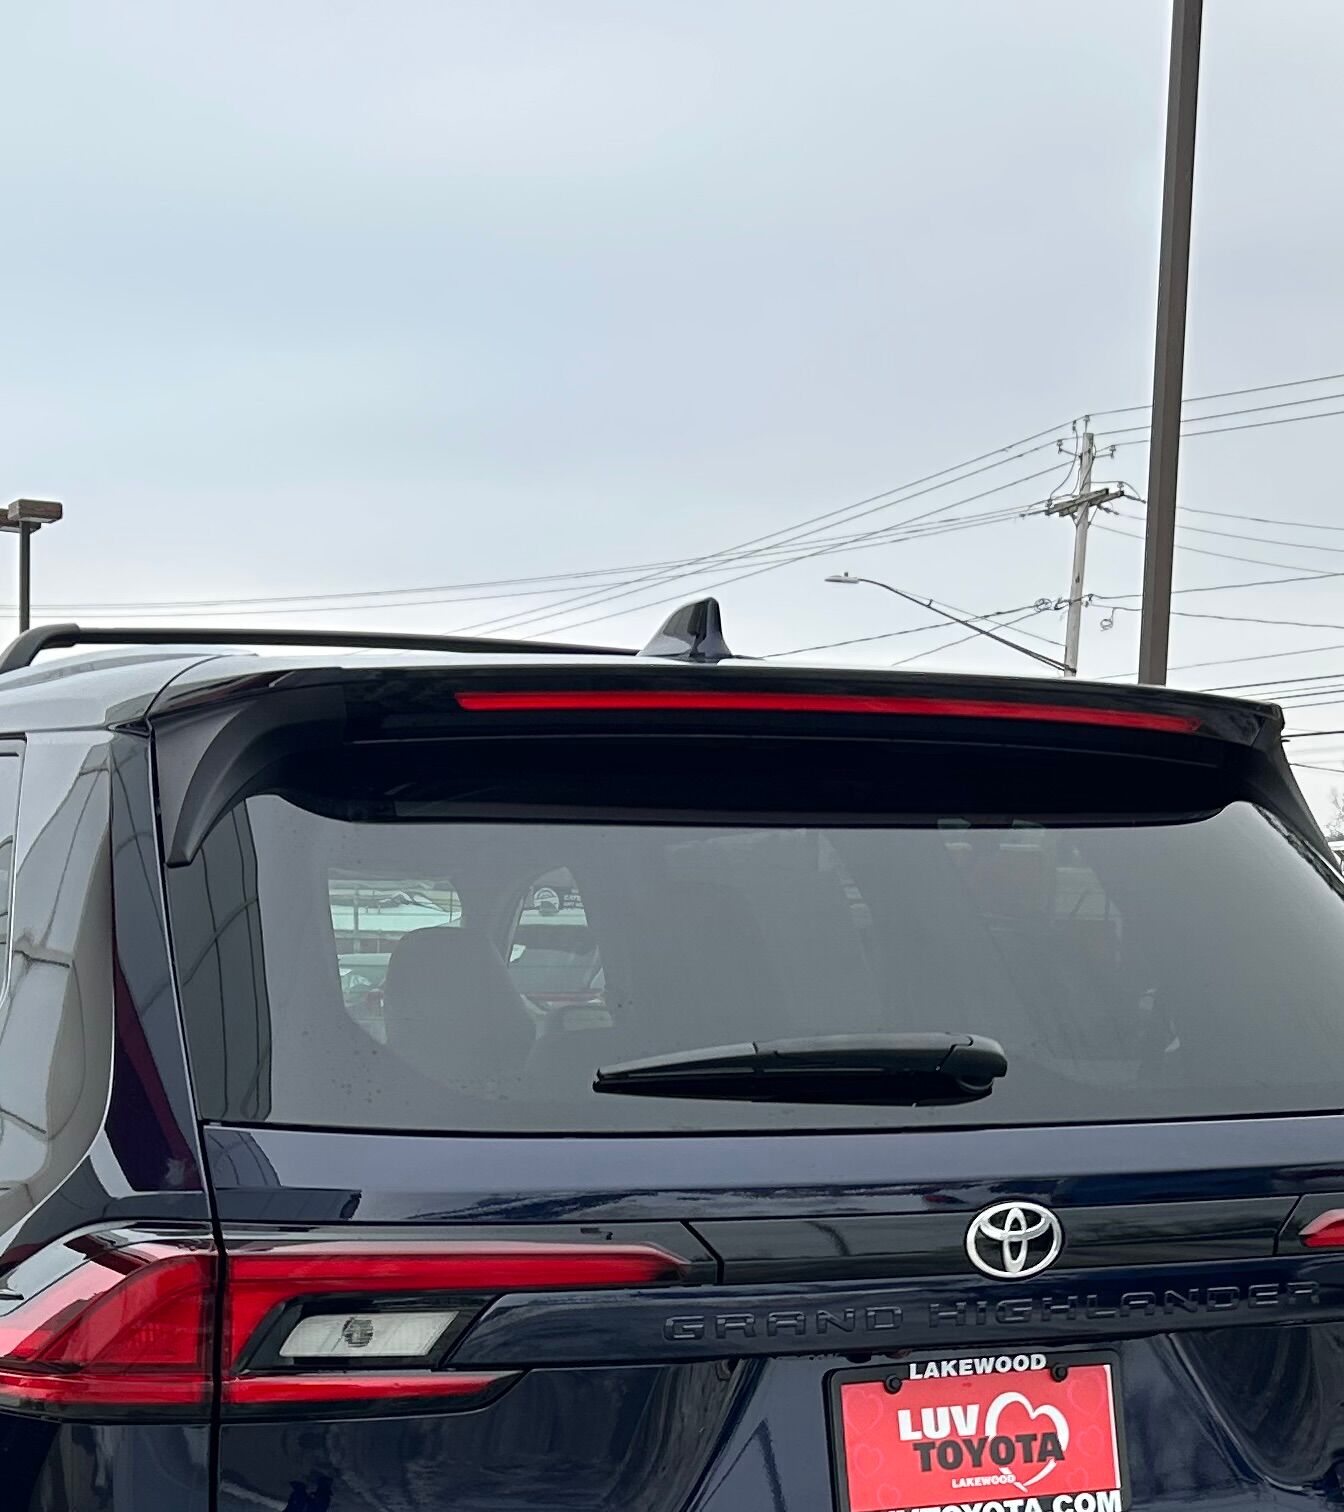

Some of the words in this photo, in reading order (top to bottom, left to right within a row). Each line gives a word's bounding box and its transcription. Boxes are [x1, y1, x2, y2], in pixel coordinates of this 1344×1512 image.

[663, 1305, 903, 1341] GRAND
[928, 1281, 1321, 1328] HIGHLANDER
[909, 1353, 1048, 1380] LAKEWOOD
[897, 1404, 980, 1441] LUV
[912, 1432, 1066, 1473] TOYOTA
[951, 1473, 1017, 1489] LAKEWOOD
